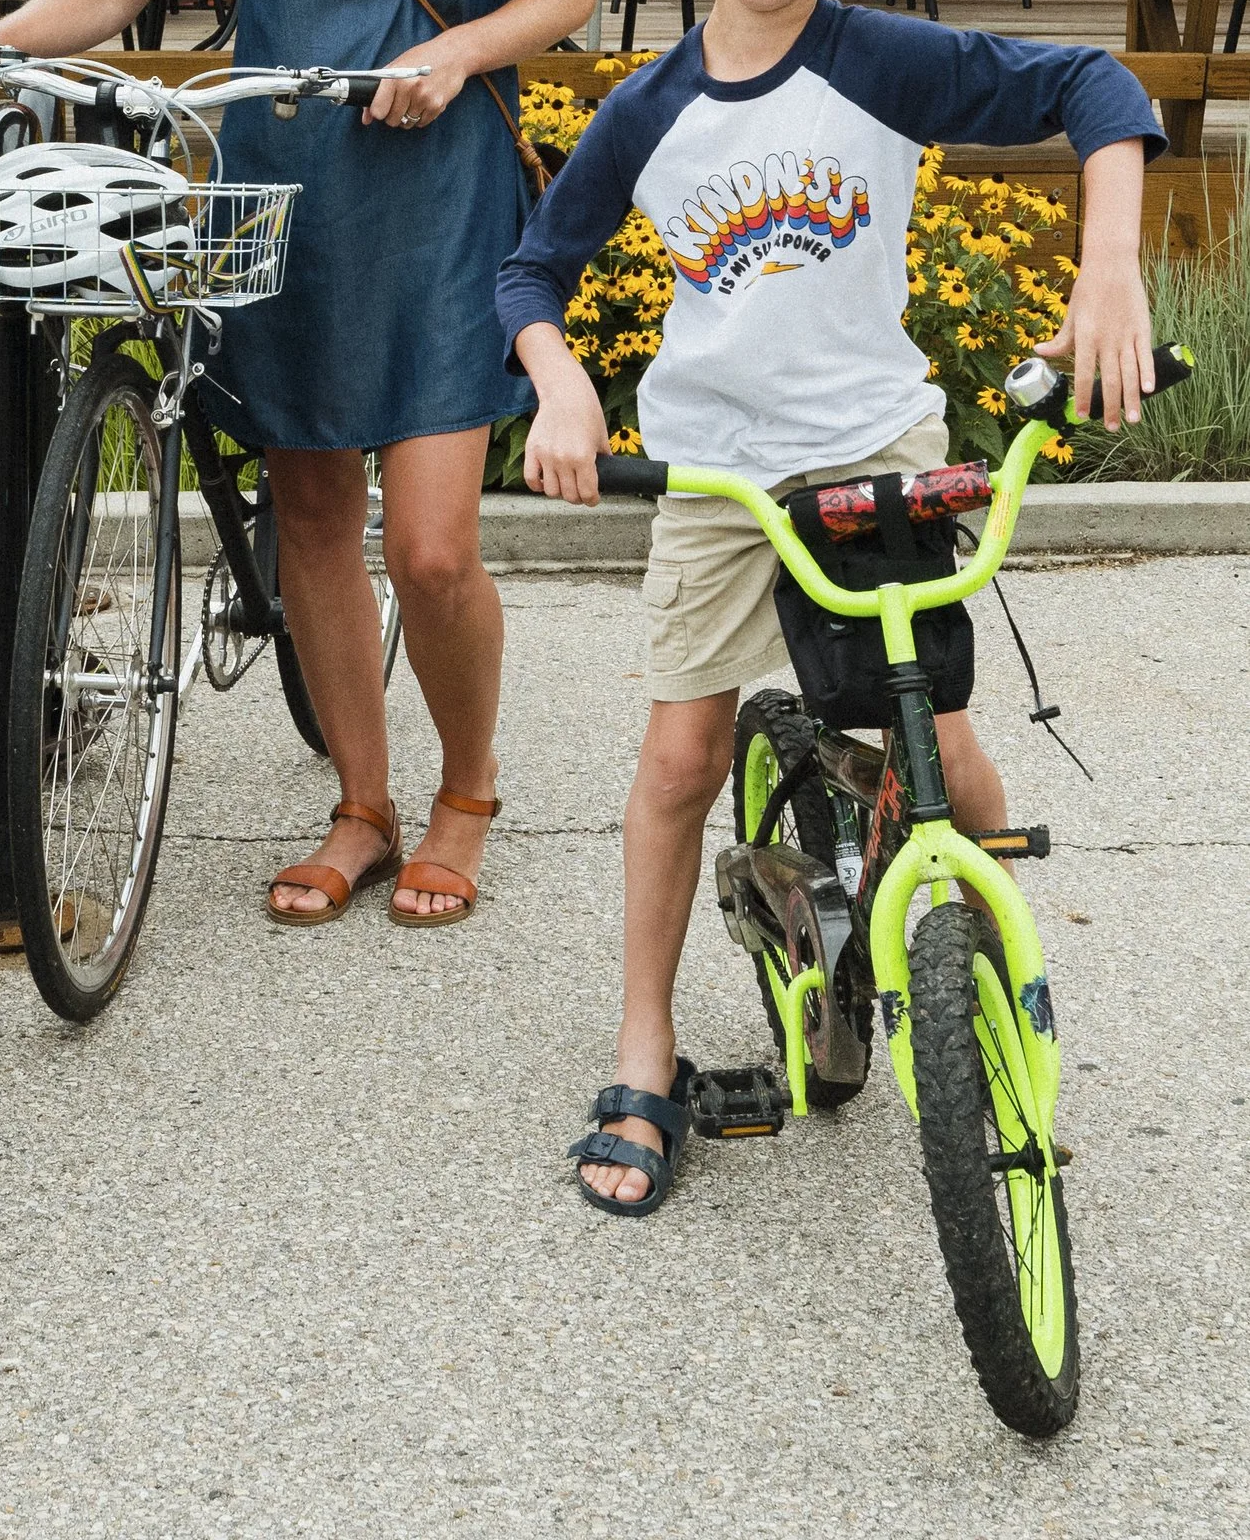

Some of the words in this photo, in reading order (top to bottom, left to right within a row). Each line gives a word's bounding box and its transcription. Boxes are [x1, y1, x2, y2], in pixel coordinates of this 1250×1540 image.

[30, 209, 88, 233] GIRO
[663, 150, 870, 294] KINDNSS
[718, 276, 736, 295] IS
[730, 253, 752, 278] MY
